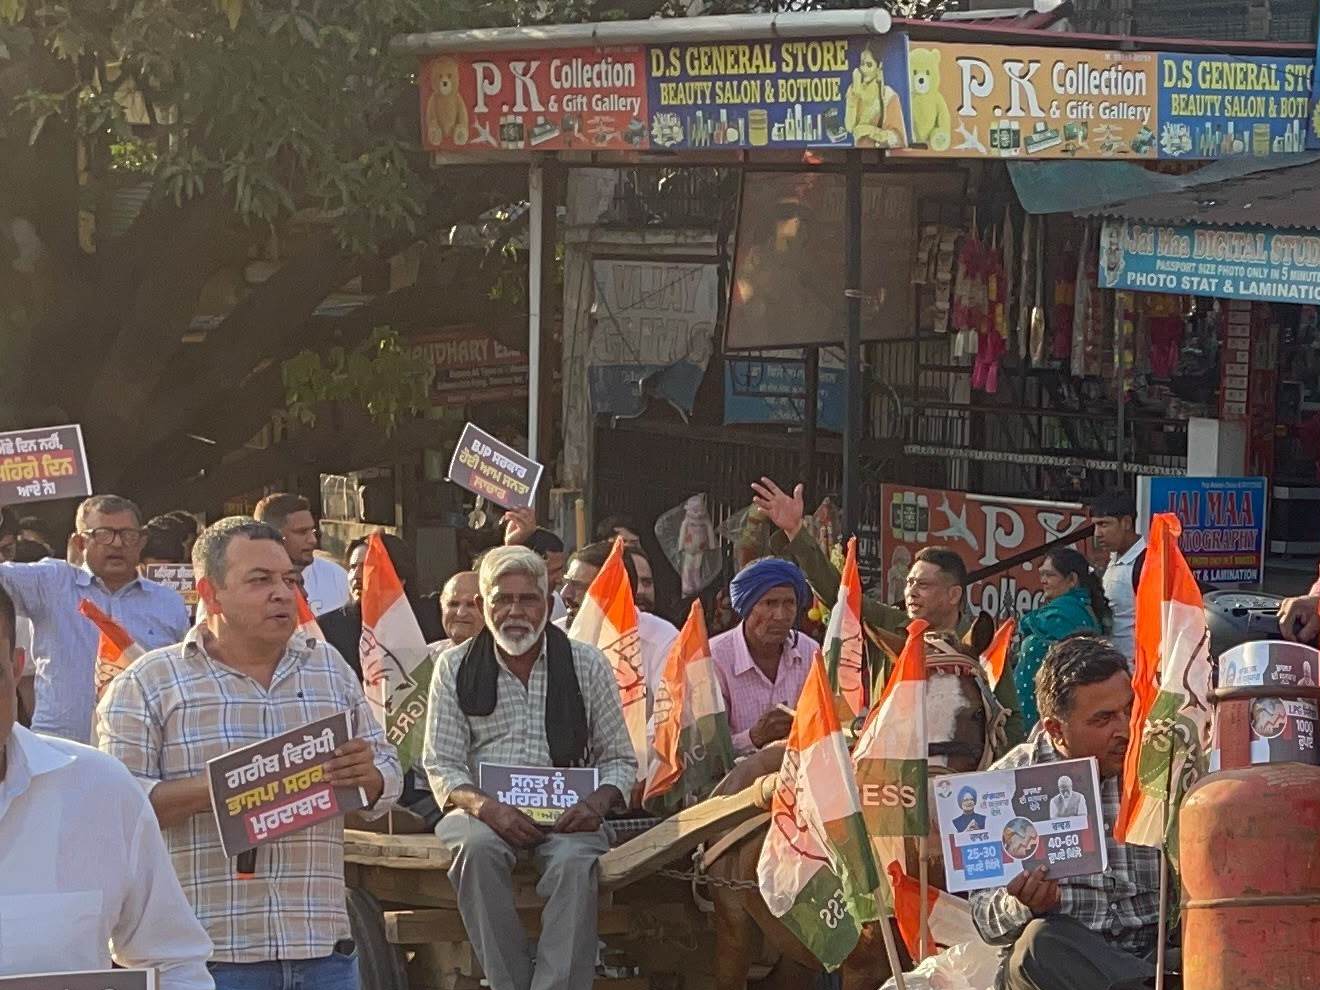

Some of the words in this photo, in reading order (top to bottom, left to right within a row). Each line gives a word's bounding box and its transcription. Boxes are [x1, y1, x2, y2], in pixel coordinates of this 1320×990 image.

[651, 47, 681, 78] D.S
[686, 43, 777, 75] GENERAL
[782, 40, 849, 71] STORE
[549, 57, 636, 91] Collection
[1052, 62, 1147, 97] Collection
[1163, 59, 1192, 90] D.S
[1197, 61, 1280, 92] GENERAL
[660, 82, 711, 105] BEAUTY
[715, 80, 760, 104] SALON
[764, 80, 775, 103] &
[778, 78, 842, 103] BOTIQUE
[548, 95, 559, 112] &
[562, 93, 589, 112] Gift
[592, 92, 641, 116] Gallery
[1050, 101, 1061, 118] &
[1066, 99, 1095, 119] Gift
[1099, 101, 1152, 125] Gallery
[1171, 95, 1222, 118] BEAUTY
[1225, 96, 1265, 118] SALON
[1267, 97, 1278, 118] &
[1193, 230, 1268, 264] DIGITAL
[1127, 272, 1176, 289] PHOTO
[1181, 276, 1218, 292] STAT
[1223, 278, 1234, 293] &
[1156, 260, 1196, 274] PASSPORT
[1198, 262, 1216, 275] SIZE
[1217, 264, 1245, 277] PHOTO
[1247, 265, 1268, 279] ONLY
[1270, 267, 1279, 279] IN
[1281, 267, 1288, 281] 5
[471, 439, 492, 457] BJP
[1205, 490, 1255, 527] MAA
[1181, 529, 1258, 552] TOGRAPHY
[1211, 569, 1257, 580] LAMINATION
[967, 846, 996, 860] 25-30
[1048, 834, 1079, 849] 40-60
